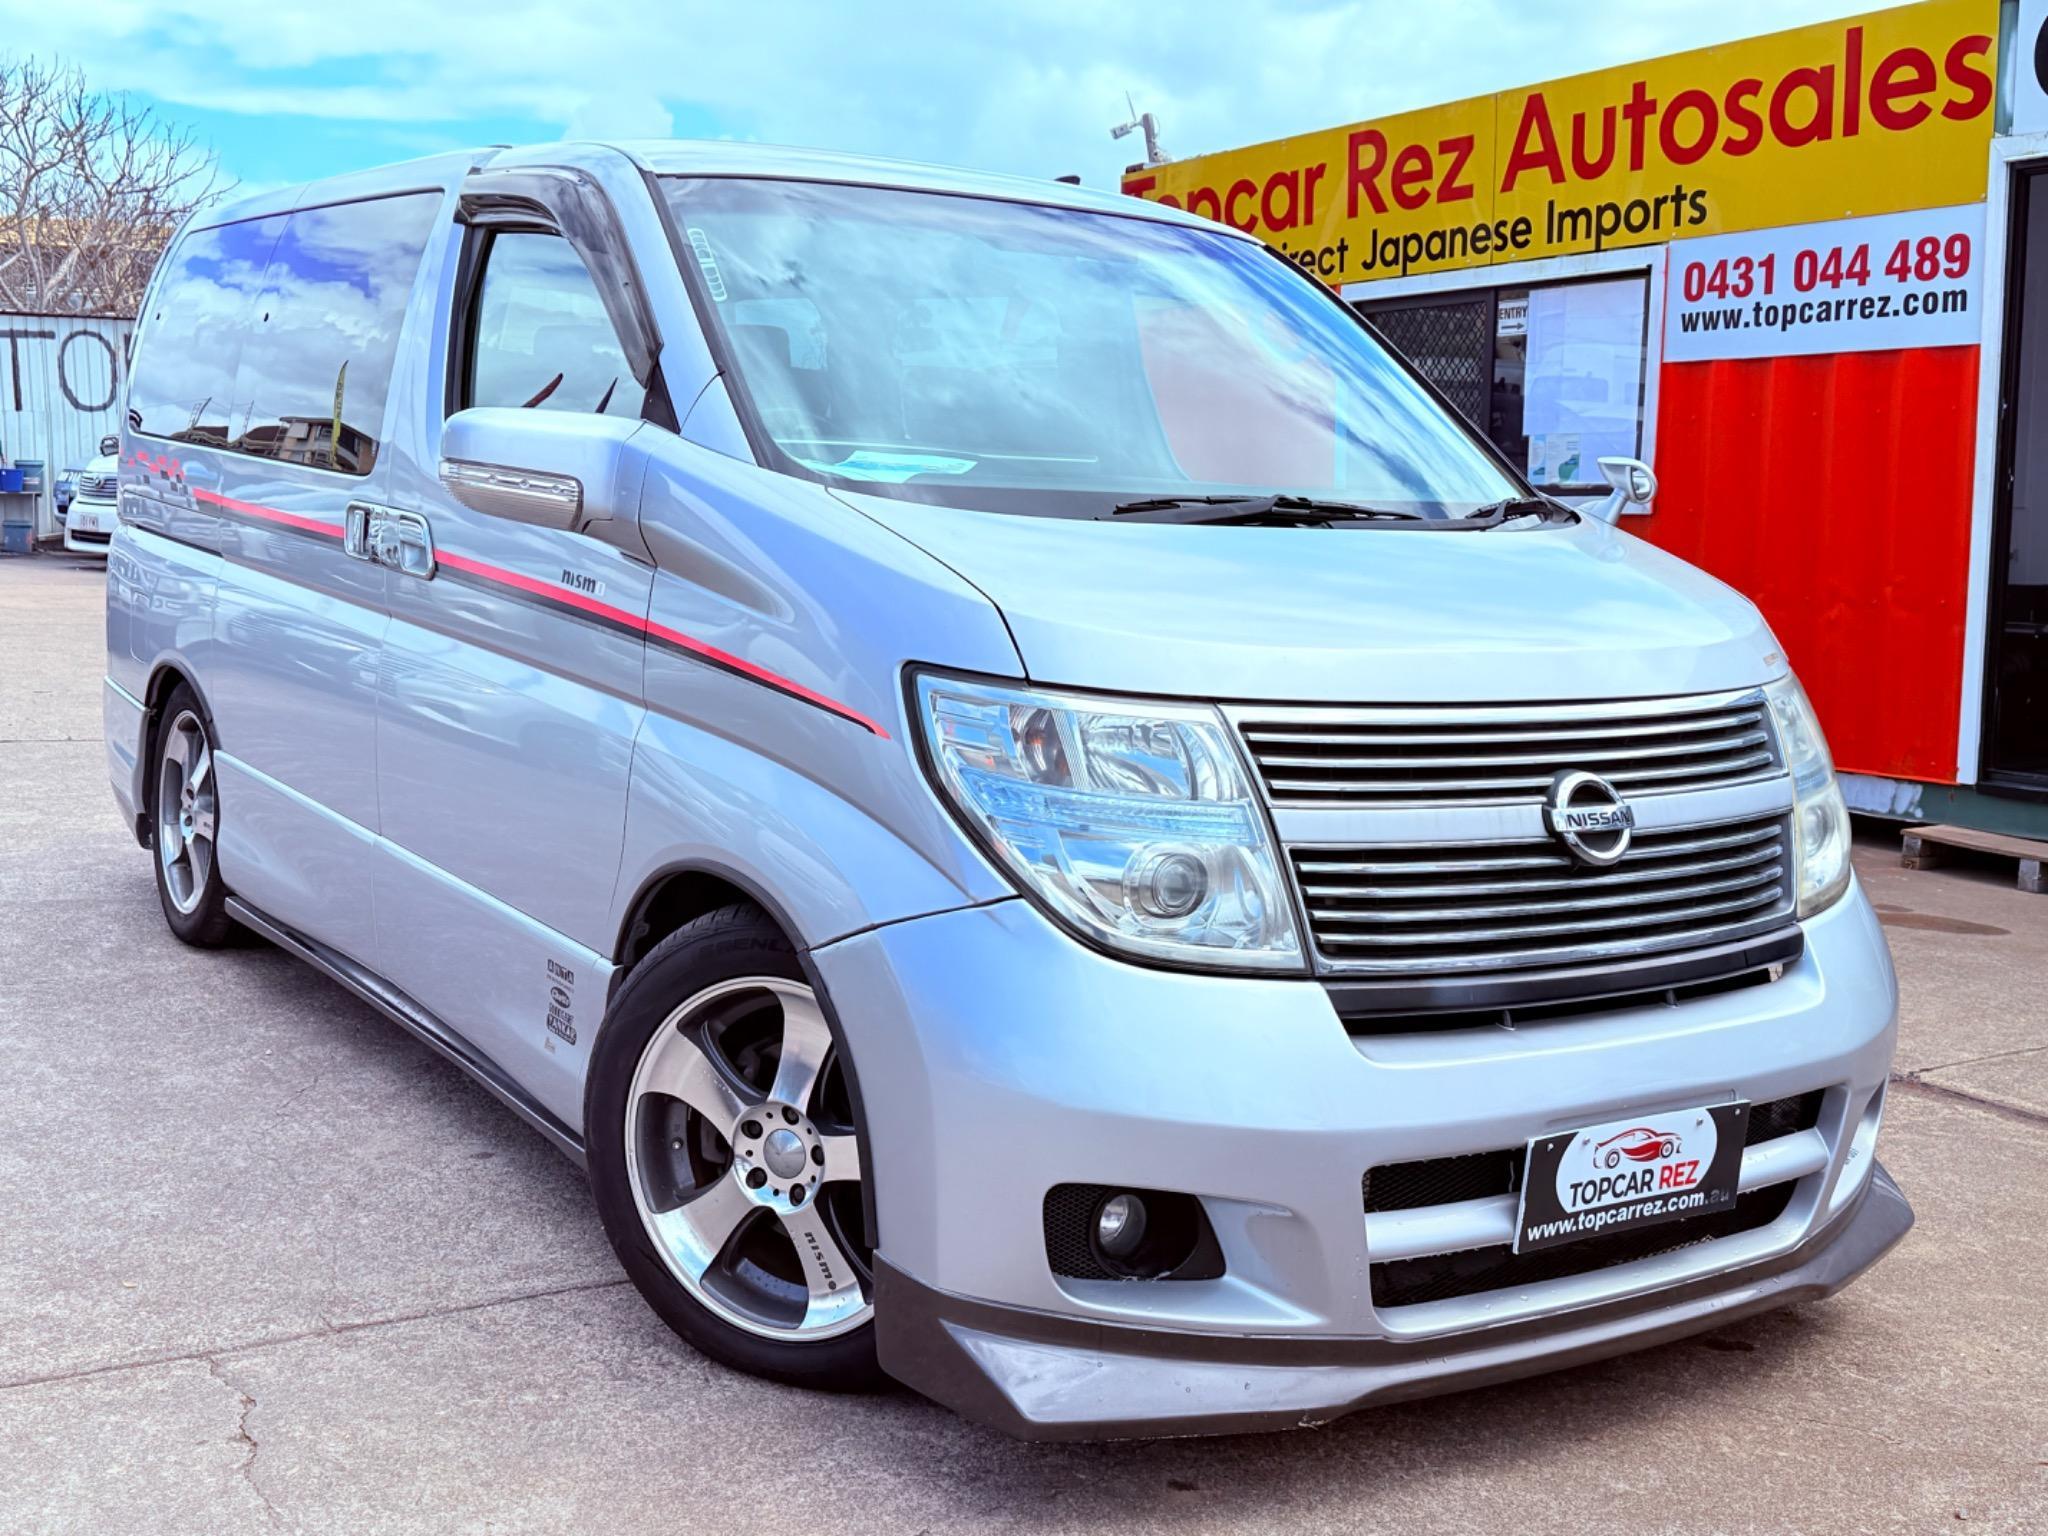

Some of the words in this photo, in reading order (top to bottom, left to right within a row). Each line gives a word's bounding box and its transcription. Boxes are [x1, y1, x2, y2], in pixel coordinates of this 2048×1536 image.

[1120, 162, 1327, 234] car
[1347, 129, 1475, 219] Rez
[1501, 25, 1993, 193] Autosales
[1362, 216, 1533, 277] Japanese
[1546, 184, 1708, 251] Imports
[1683, 253, 1775, 302] 0431
[1793, 244, 1871, 292] 044
[1885, 233, 1971, 283] 489
[1499, 305, 1528, 320] ENTRY
[1681, 288, 1968, 333] www.topcarrez.com
[1566, 810, 1631, 827] NISSAN
[1570, 1168, 1655, 1207] TOPCAR
[1658, 1160, 1700, 1189] REZ
